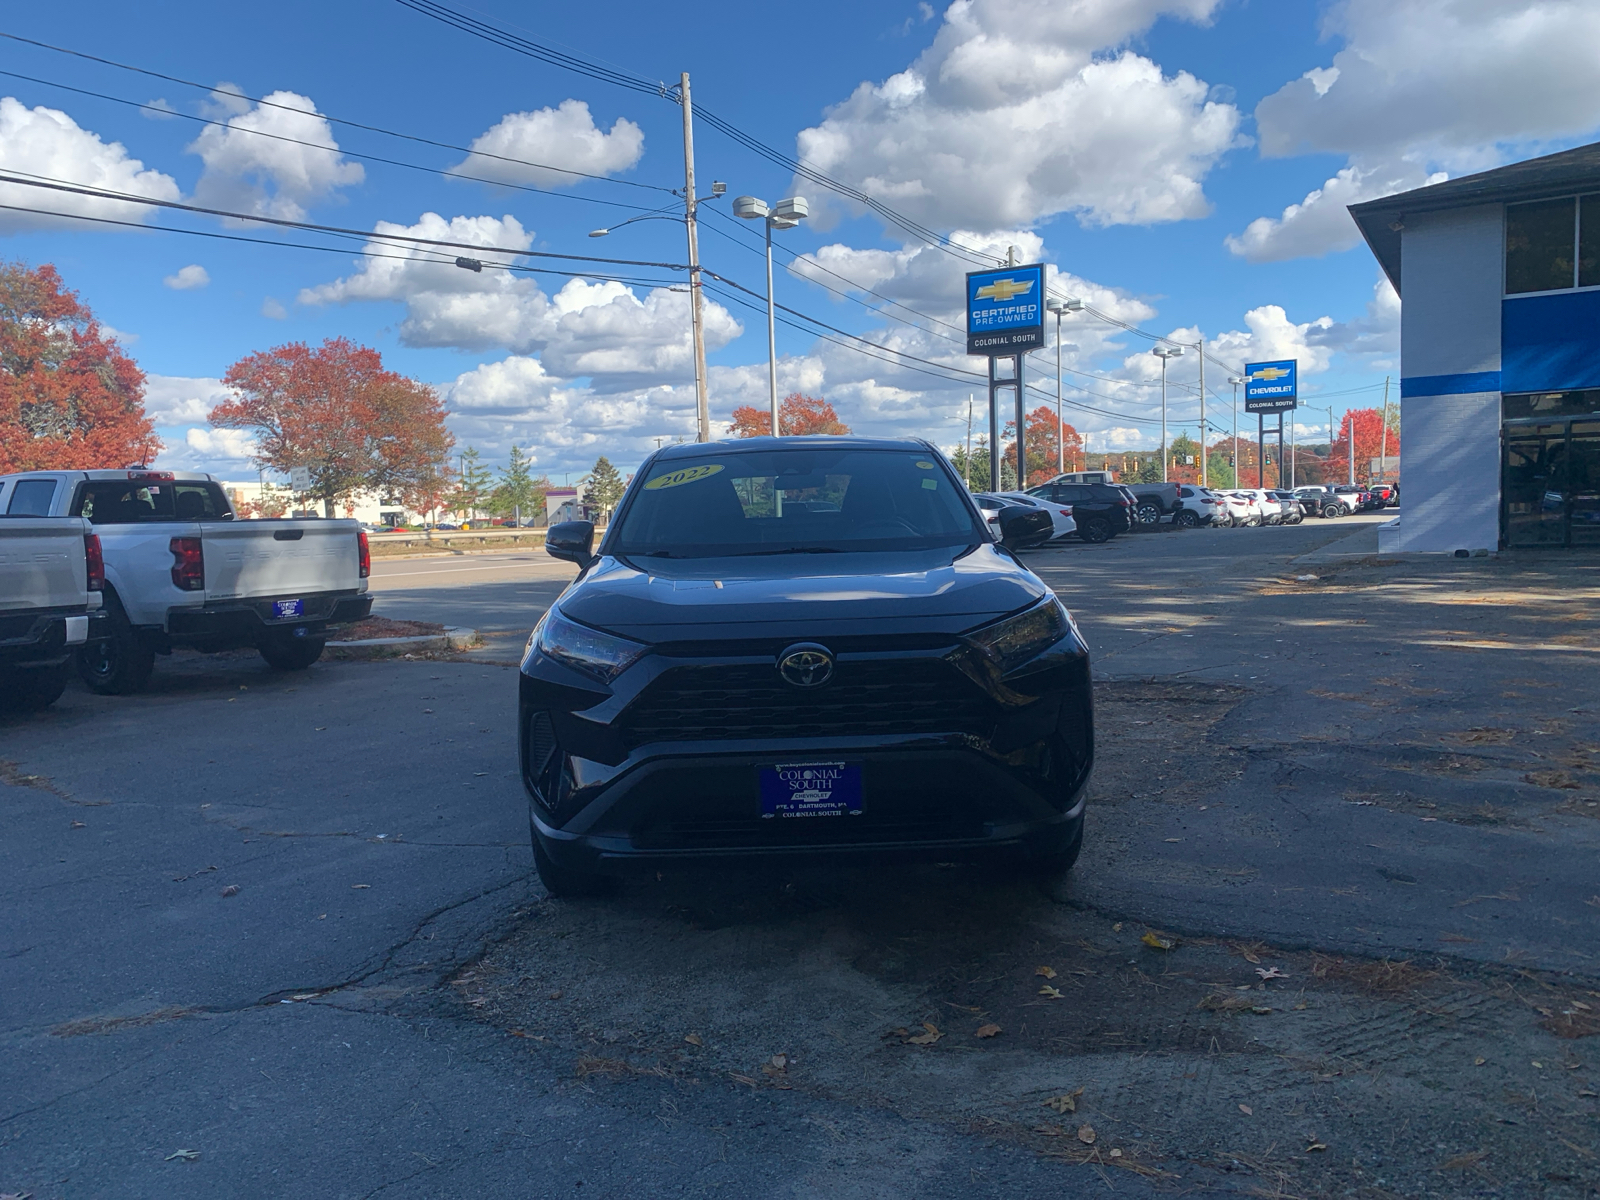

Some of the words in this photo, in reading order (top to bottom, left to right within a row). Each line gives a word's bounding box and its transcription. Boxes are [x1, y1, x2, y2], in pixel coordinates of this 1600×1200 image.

[972, 304, 1037, 318] CERTIFIED
[975, 312, 1034, 326] PRE-OWNED
[974, 337, 1008, 347] COLONIAL
[1012, 334, 1036, 343] SOUTH
[1249, 385, 1293, 395] CHEVROLET
[660, 466, 711, 487] 2022
[225, 546, 348, 563] CHEVROLET
[779, 769, 842, 780] COLONIAL
[789, 779, 832, 790] SOUTH
